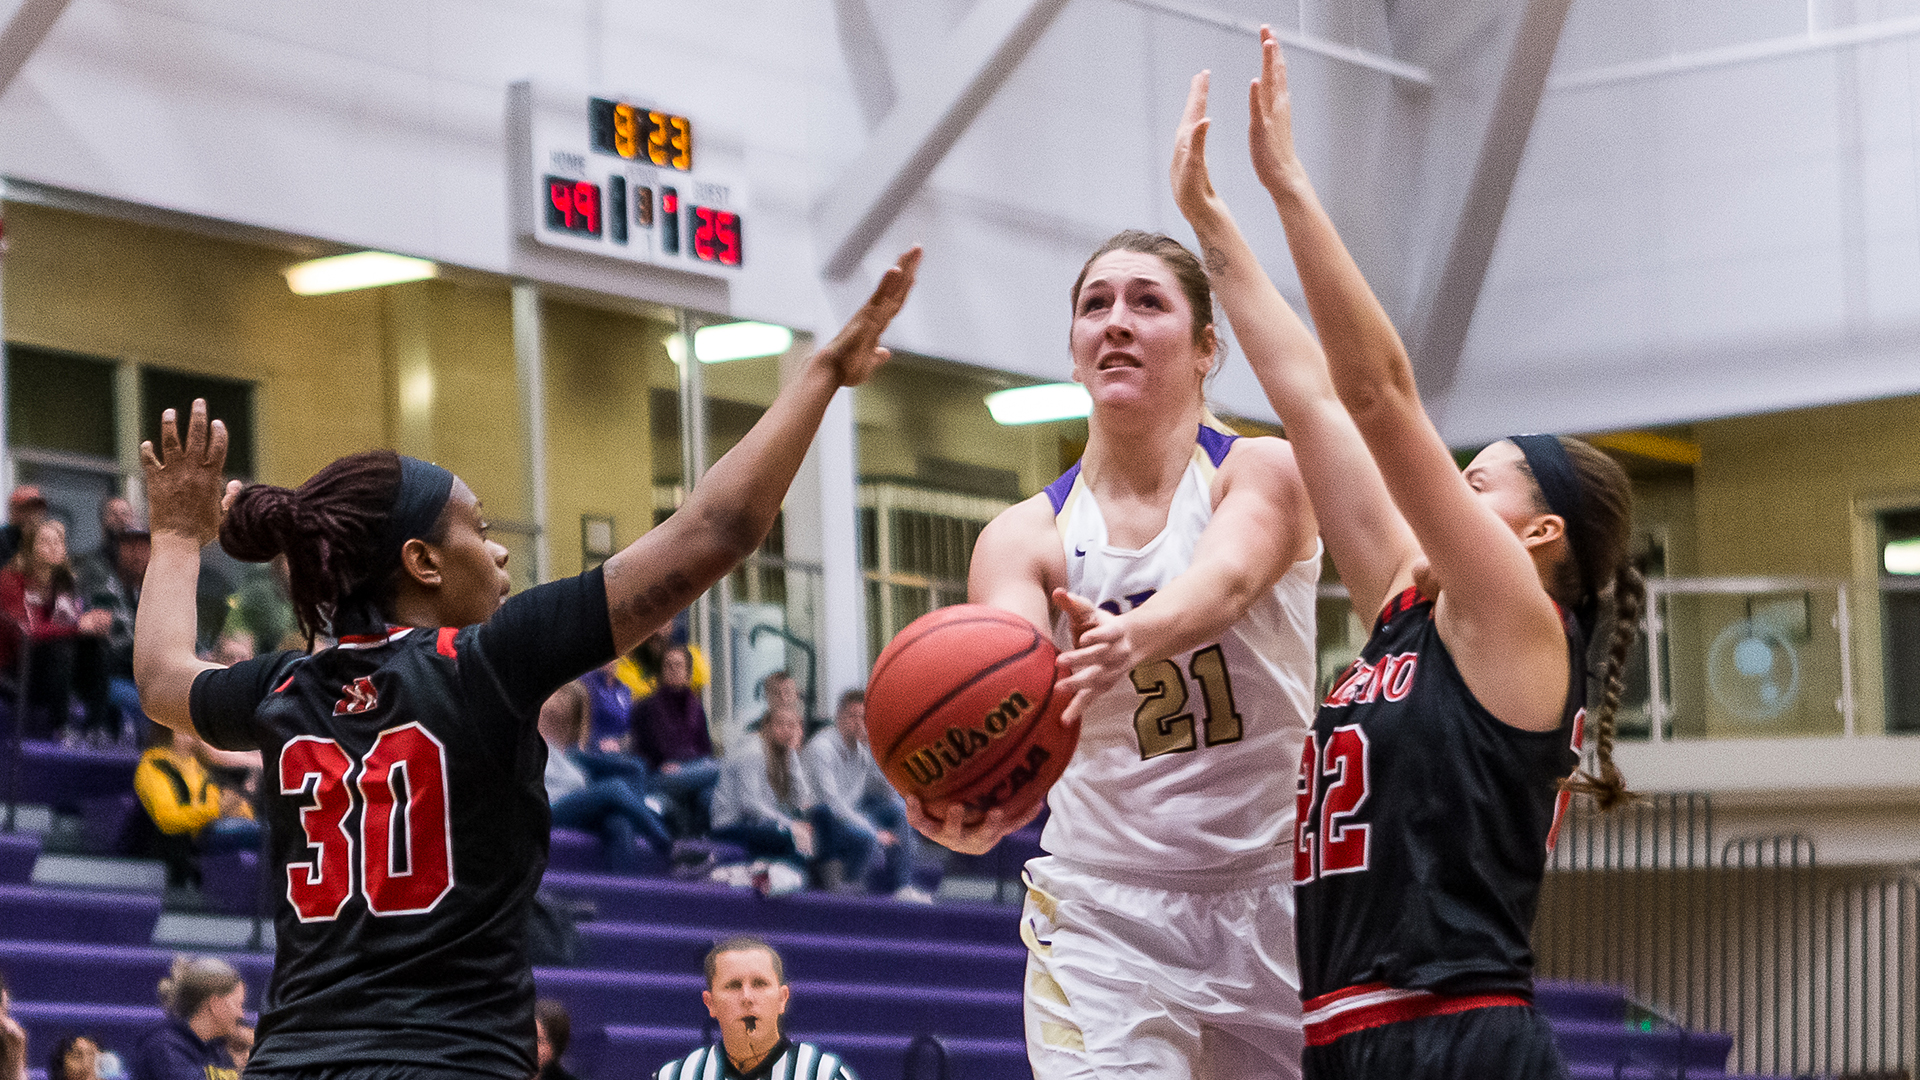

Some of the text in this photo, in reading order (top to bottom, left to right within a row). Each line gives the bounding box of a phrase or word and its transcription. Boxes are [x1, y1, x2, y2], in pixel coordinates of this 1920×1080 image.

[551, 180, 596, 233] 49
[694, 206, 741, 266] 25
[903, 689, 1035, 786] Wilson
[1129, 643, 1243, 761] 21
[279, 720, 455, 924] 30
